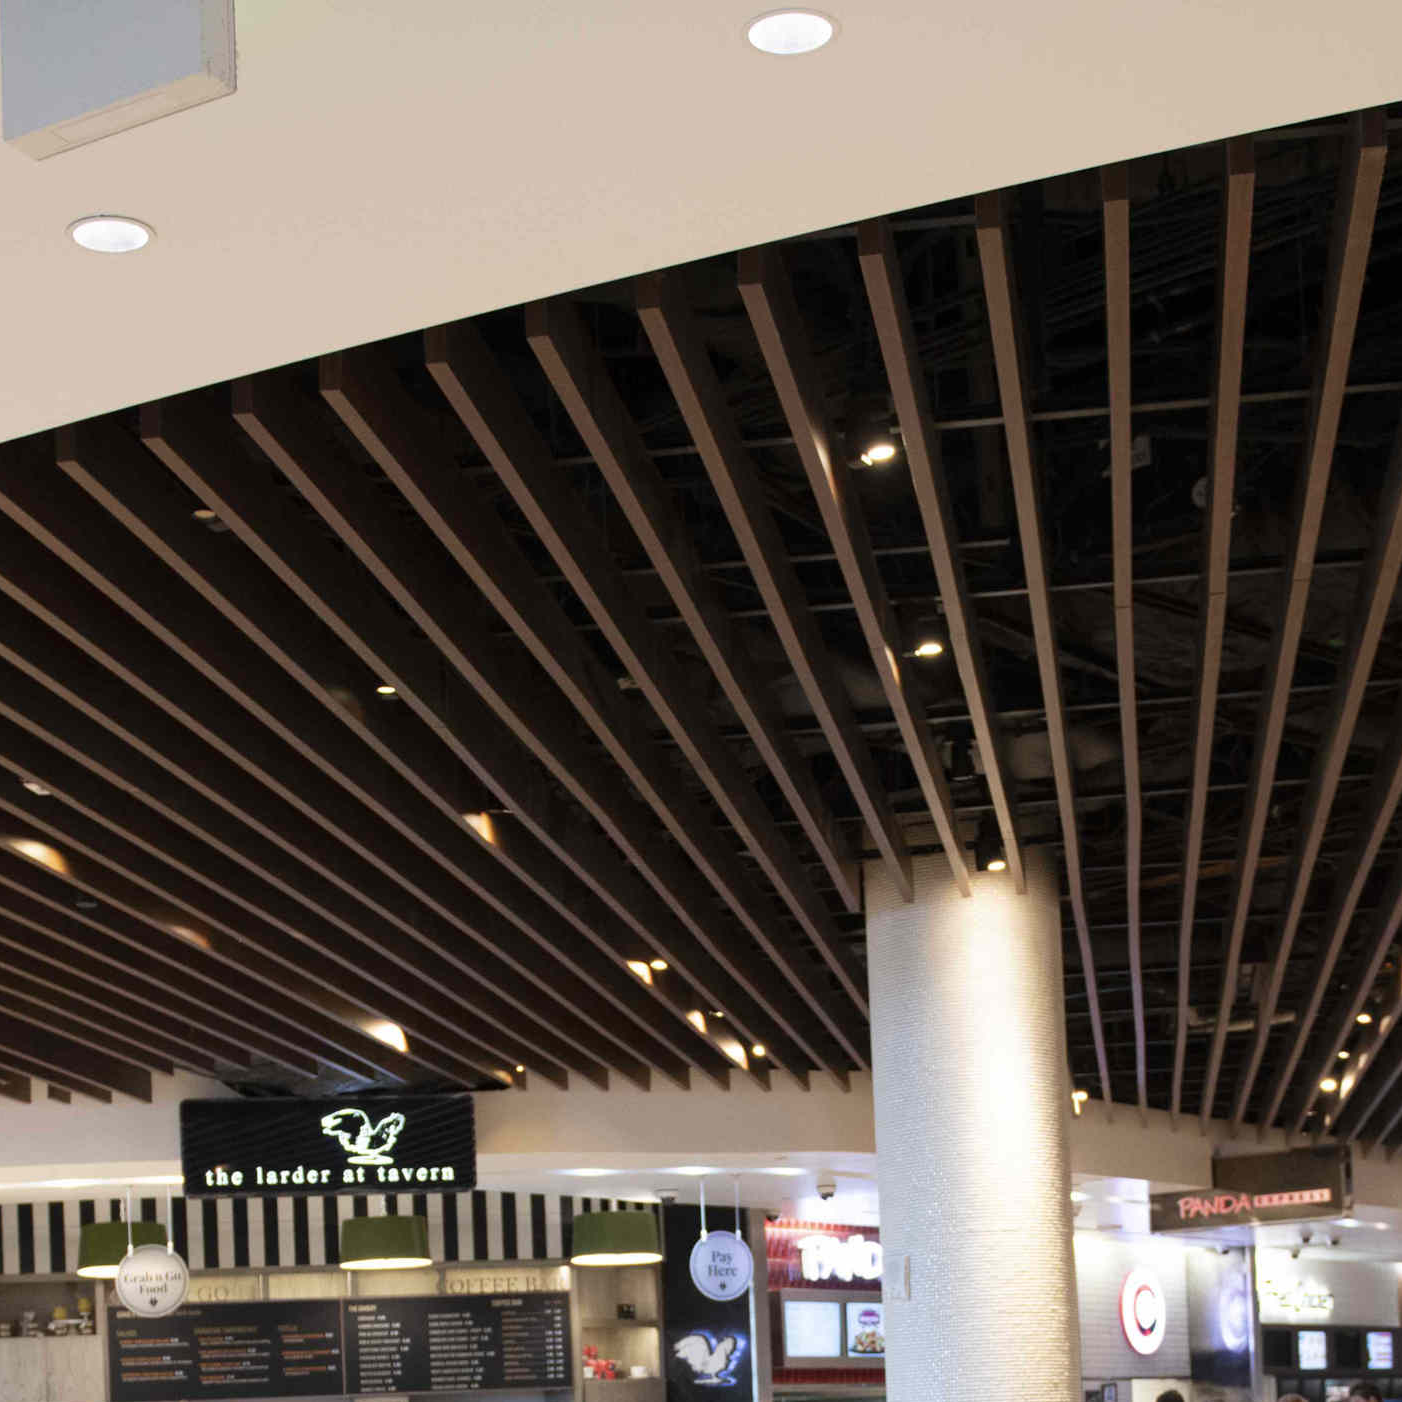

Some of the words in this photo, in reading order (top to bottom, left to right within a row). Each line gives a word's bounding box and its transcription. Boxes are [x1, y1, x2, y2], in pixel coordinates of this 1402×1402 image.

[205, 1166, 243, 1187] the
[256, 1165, 332, 1186] larder
[343, 1167, 365, 1183] at
[377, 1166, 455, 1183] tavern
[1178, 1194, 1252, 1219] PANDA
[711, 1250, 733, 1264] Pay
[123, 1271, 154, 1283] Grab
[708, 1264, 738, 1277] Here
[139, 1283, 168, 1295] Food
